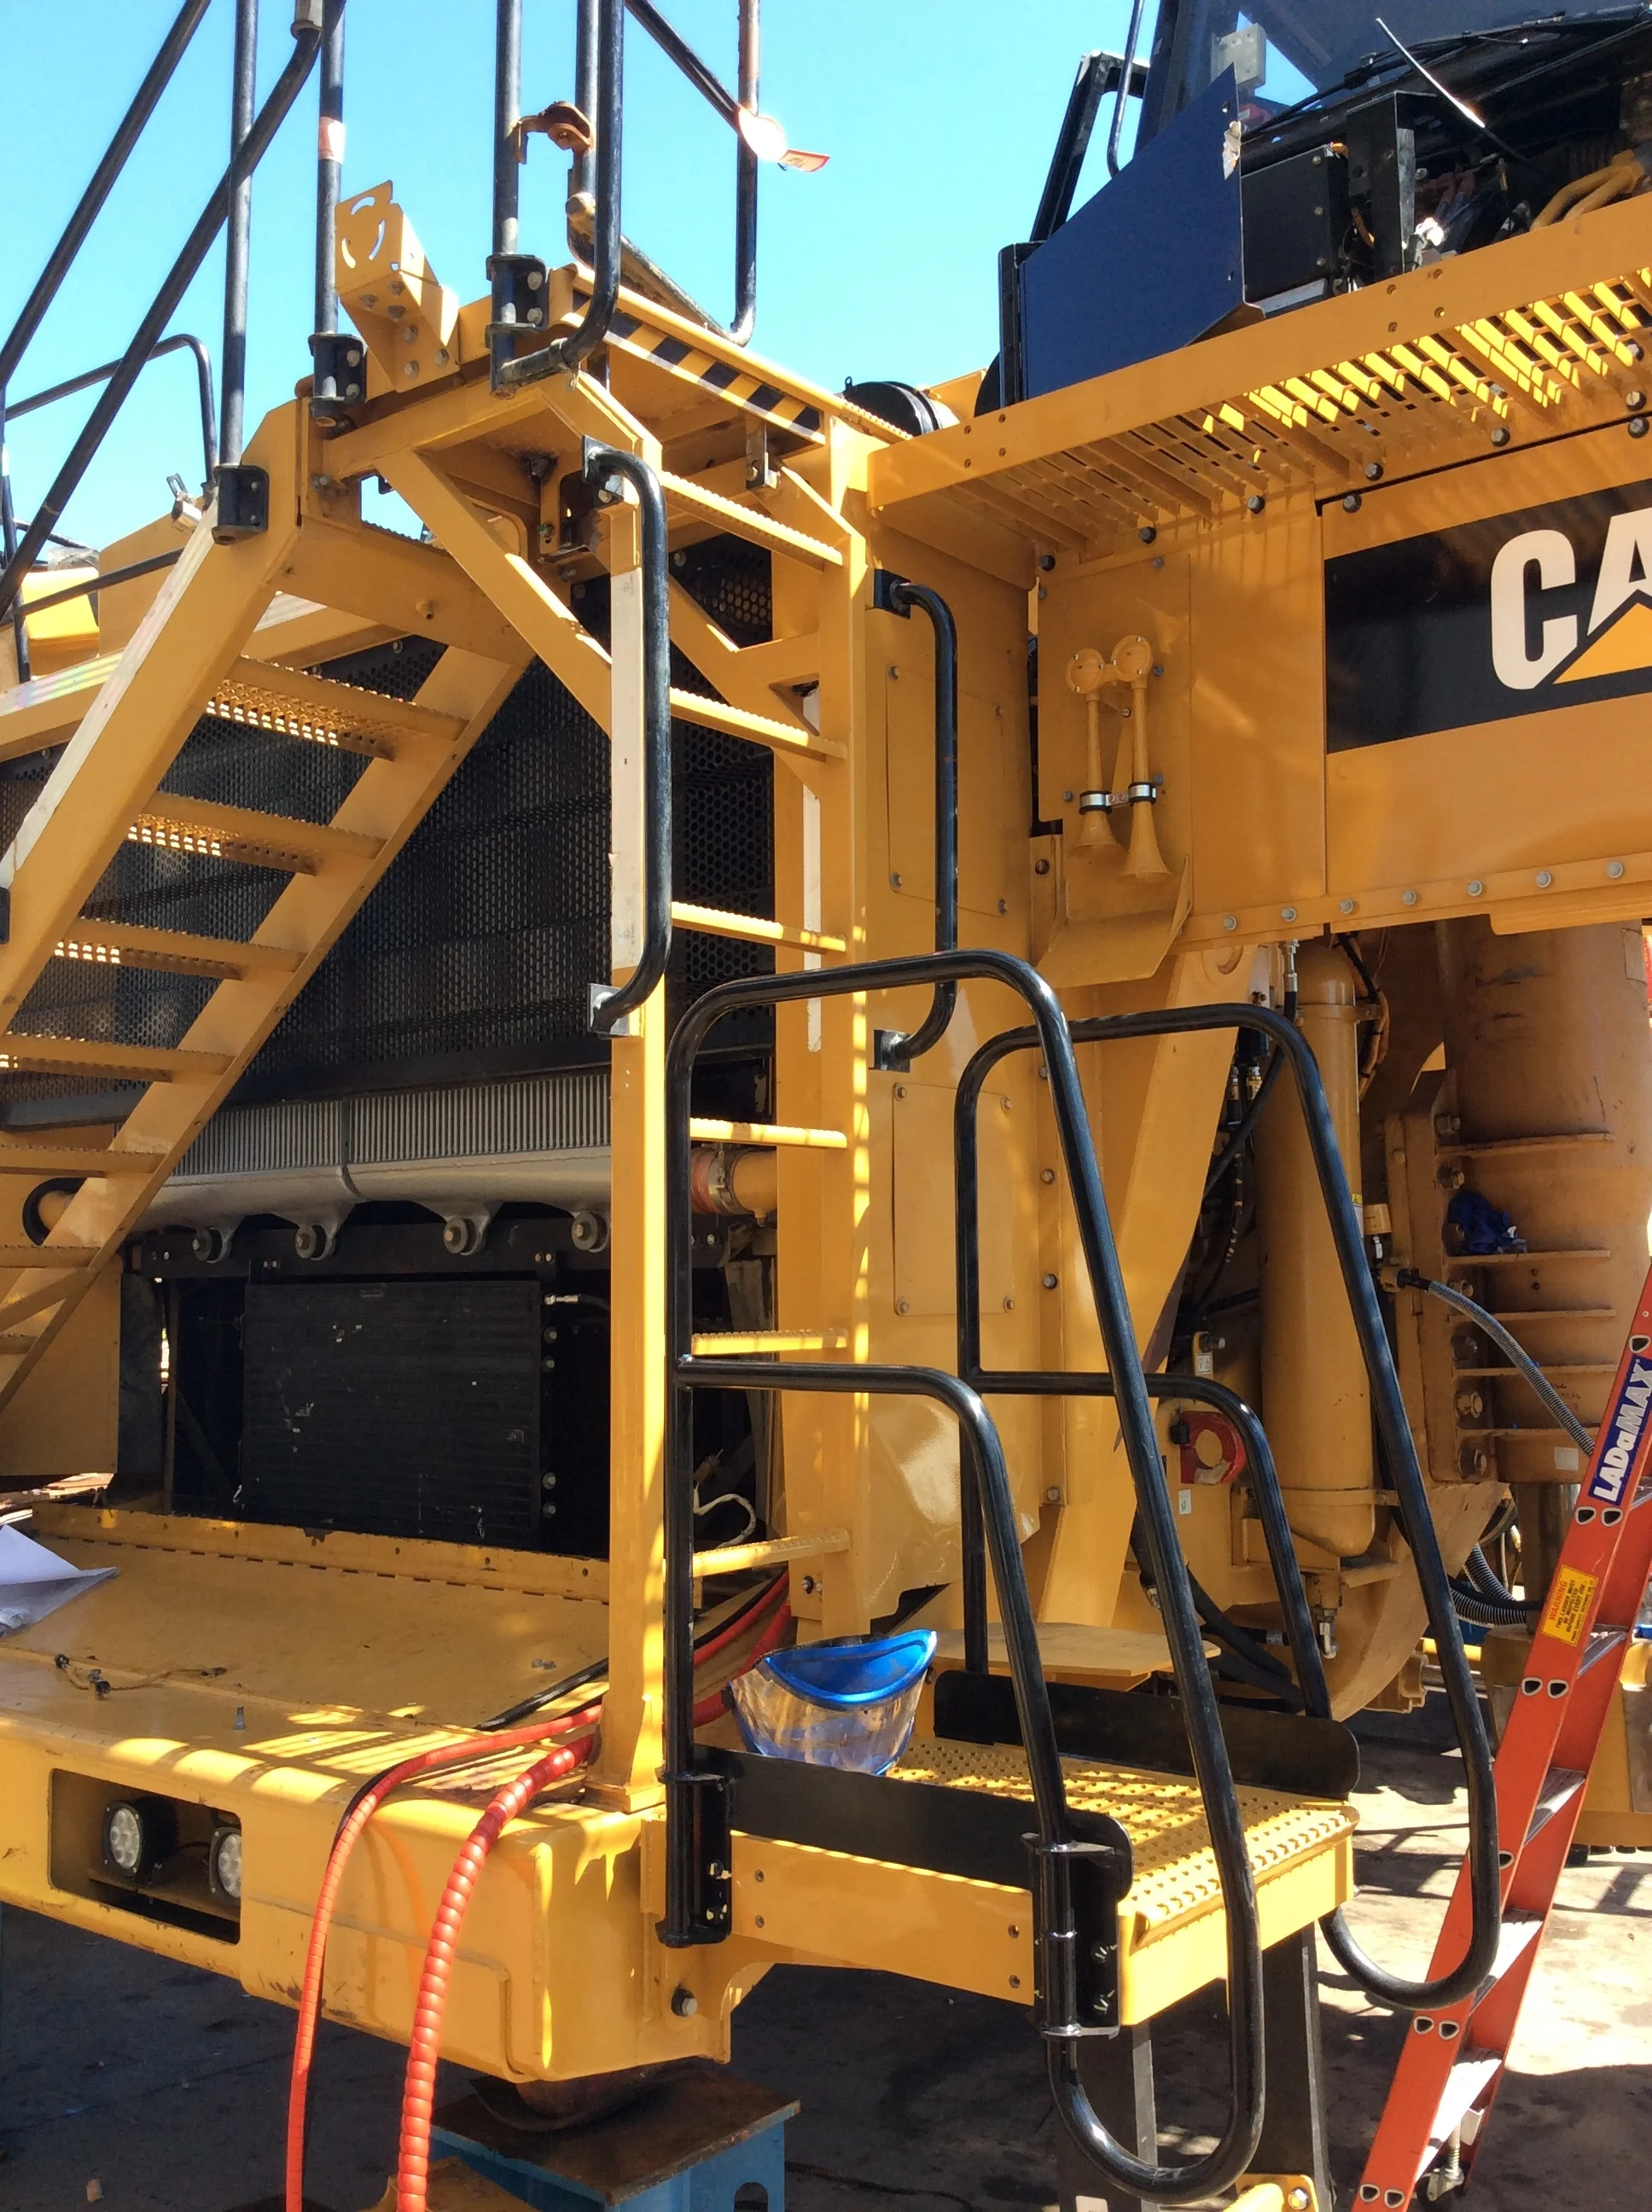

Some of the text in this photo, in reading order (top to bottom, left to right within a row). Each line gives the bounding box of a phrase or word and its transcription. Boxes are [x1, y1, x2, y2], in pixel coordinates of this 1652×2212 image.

[1549, 1580, 1568, 1621] WARNING
[1560, 1596, 1570, 1615] LADDER
[1566, 1587, 1579, 1615] INSPECTED
[1566, 1613, 1576, 1633] BEFORE
[1573, 1595, 1582, 1612] EVERY
